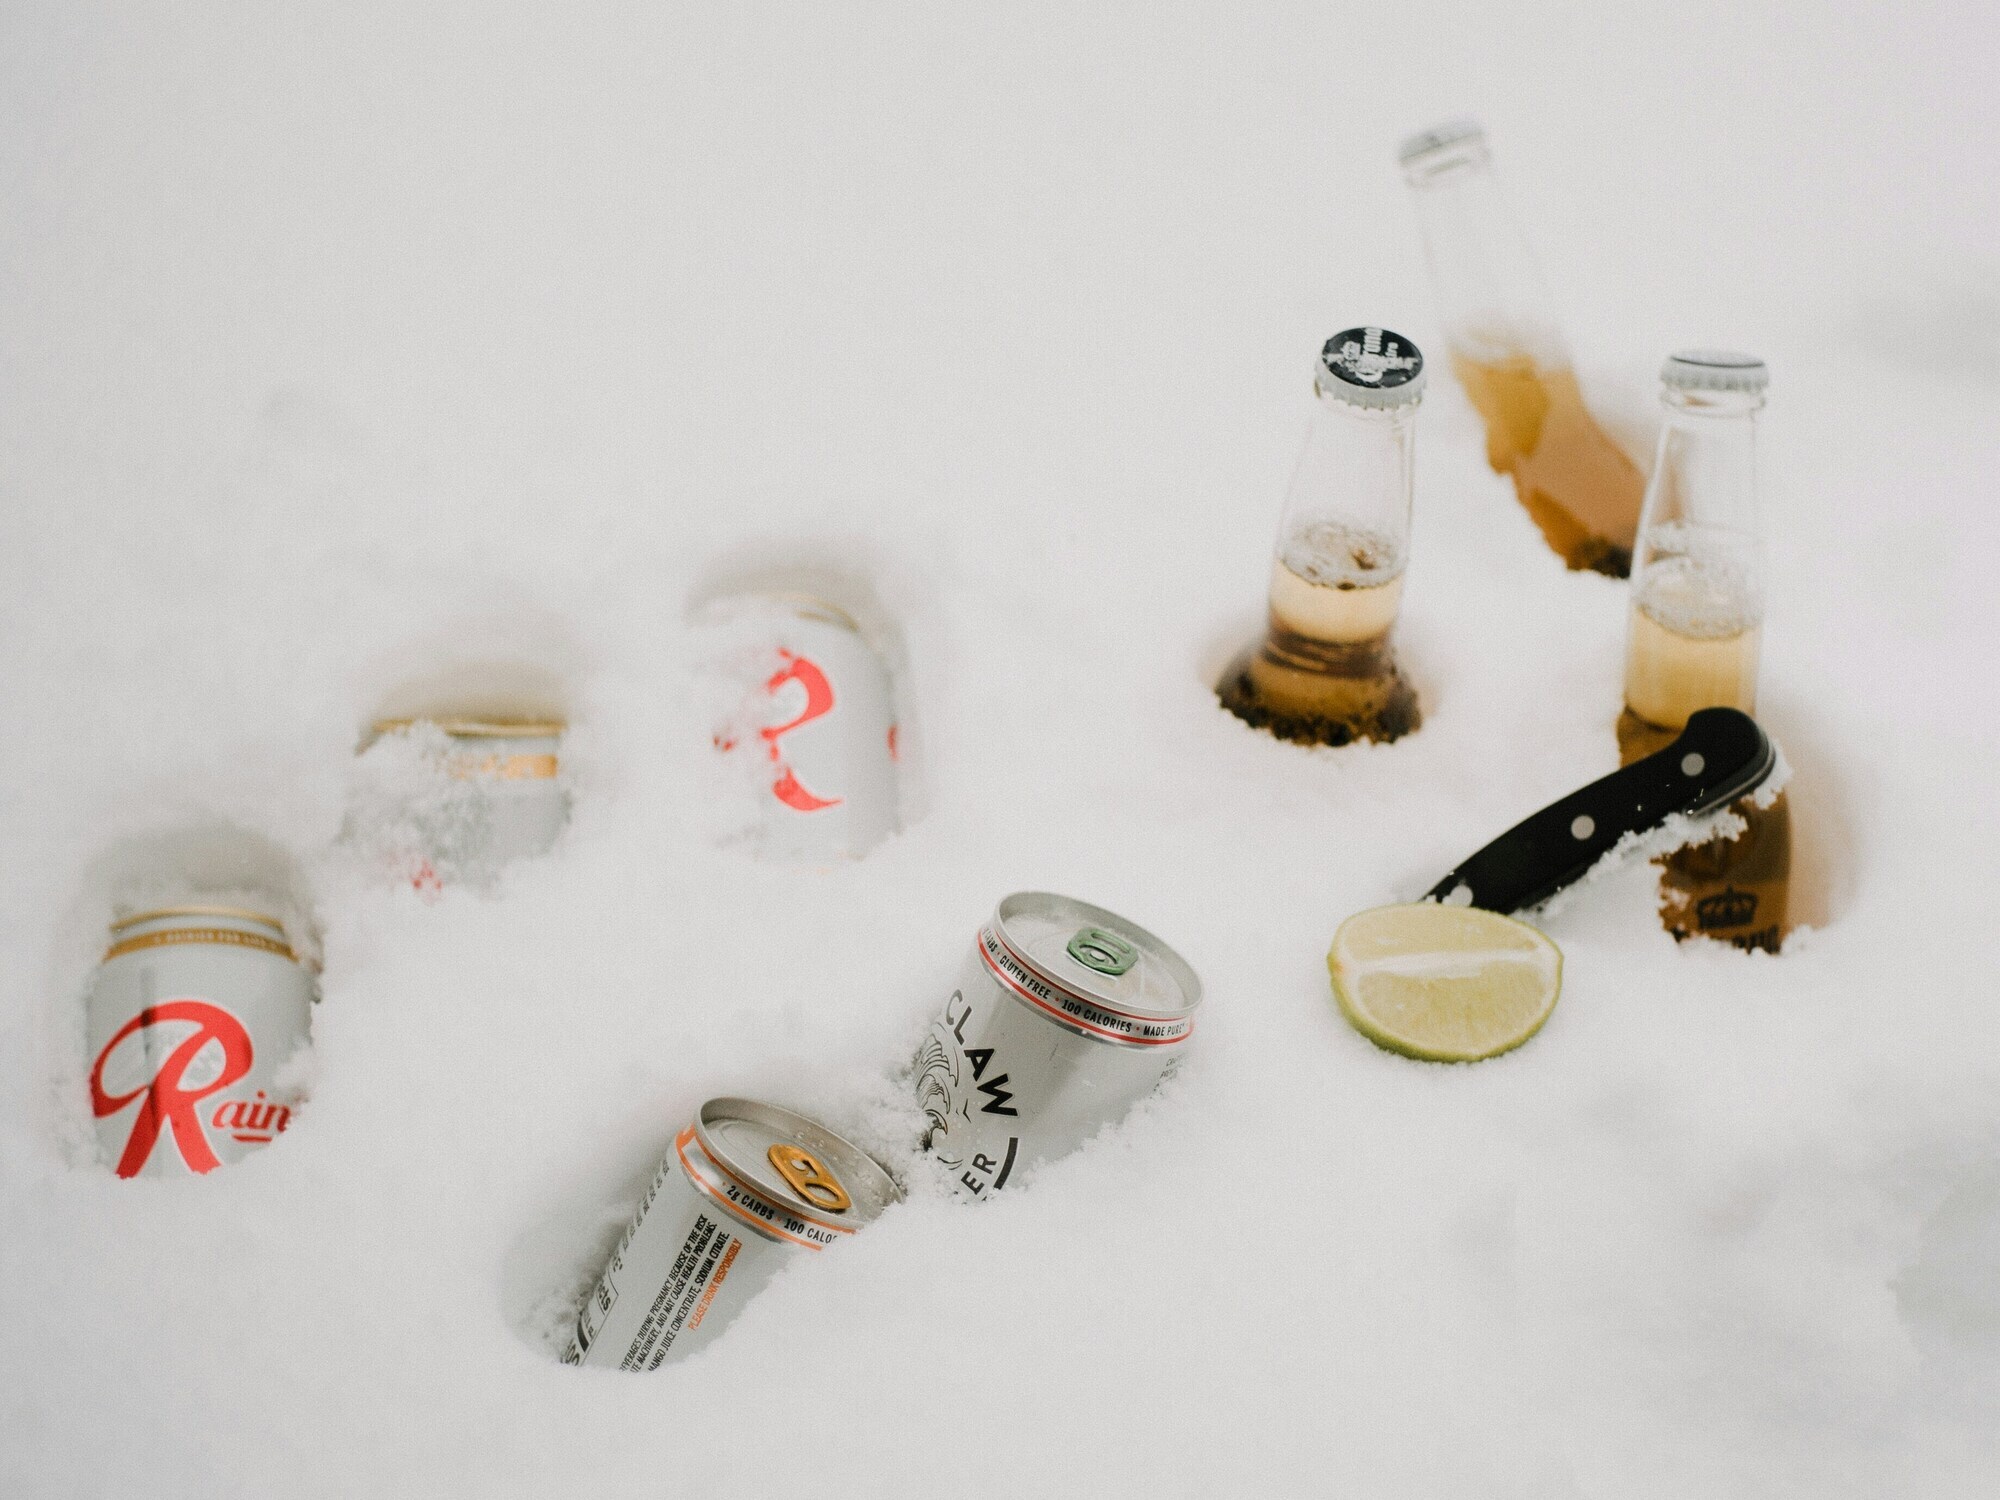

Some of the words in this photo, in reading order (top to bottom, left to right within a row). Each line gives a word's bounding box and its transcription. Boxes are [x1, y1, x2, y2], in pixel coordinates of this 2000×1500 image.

[1000, 955, 1028, 984] GLUTEN
[1027, 979, 1051, 999] FREE
[1061, 1000, 1081, 1015] 100
[1083, 1009, 1132, 1033] CALORIES
[1143, 1025, 1165, 1037] MADE
[946, 989, 1018, 1116] CLAW
[961, 1153, 997, 1198] ER
[694, 1213, 708, 1232] RISK
[727, 1185, 741, 1199] 2g
[741, 1195, 775, 1220] CARBS
[784, 1218, 805, 1234] 100
[682, 1240, 692, 1254] OF
[686, 1228, 700, 1244] THE
[692, 1220, 717, 1257] PROBLEMS.
[667, 1250, 688, 1281] BECAUSE
[679, 1253, 698, 1280] HEALTH
[649, 1277, 673, 1316] PREGNANCY
[659, 1329, 676, 1351] JUICE
[669, 1284, 701, 1332] CONCENTRATE,
[693, 1256, 715, 1286] SODIUM
[707, 1230, 729, 1259] CITRATE.
[669, 1277, 686, 1300] CAUSE
[688, 1302, 708, 1331] PLEASE
[699, 1280, 719, 1306] DRINK
[711, 1236, 742, 1285] RESPONSIBLY
[655, 1311, 668, 1329] AND
[661, 1297, 674, 1315] MAY
[636, 1313, 655, 1340] DURING
[635, 1326, 661, 1365] MACHINERY,
